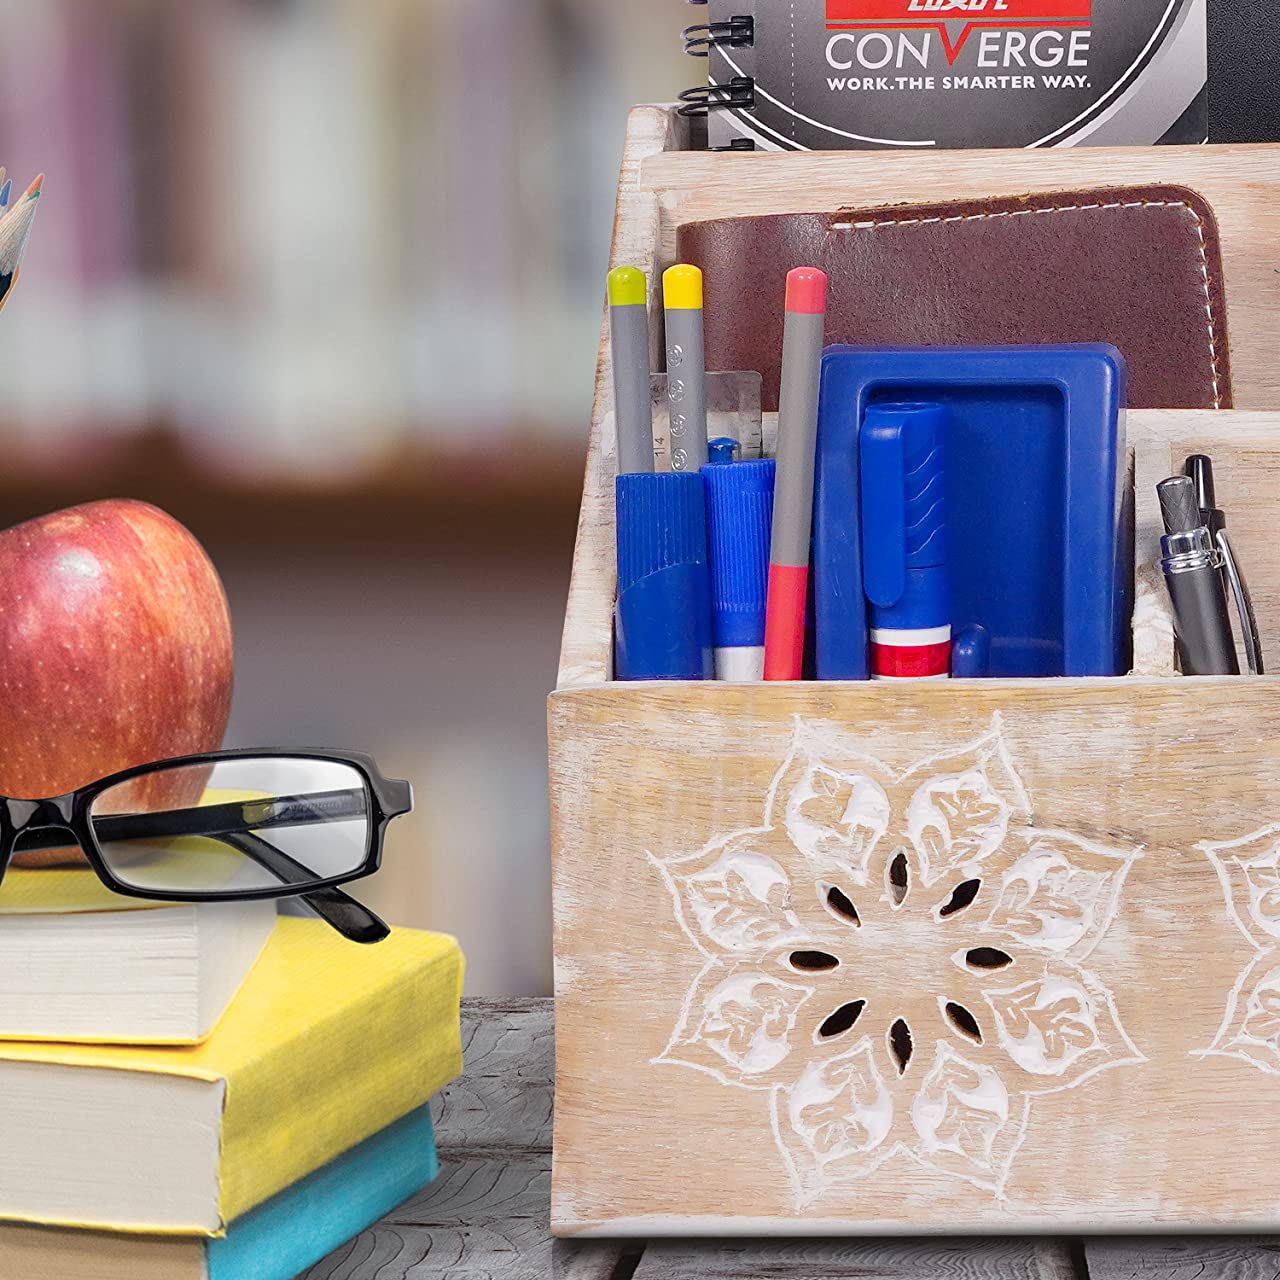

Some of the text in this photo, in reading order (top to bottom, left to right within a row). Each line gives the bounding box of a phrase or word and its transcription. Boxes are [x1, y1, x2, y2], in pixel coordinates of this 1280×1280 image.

[826, 23, 1091, 70] CONVERGE
[943, 76, 1035, 89] SMARTER
[1042, 75, 1091, 89] WAY.
